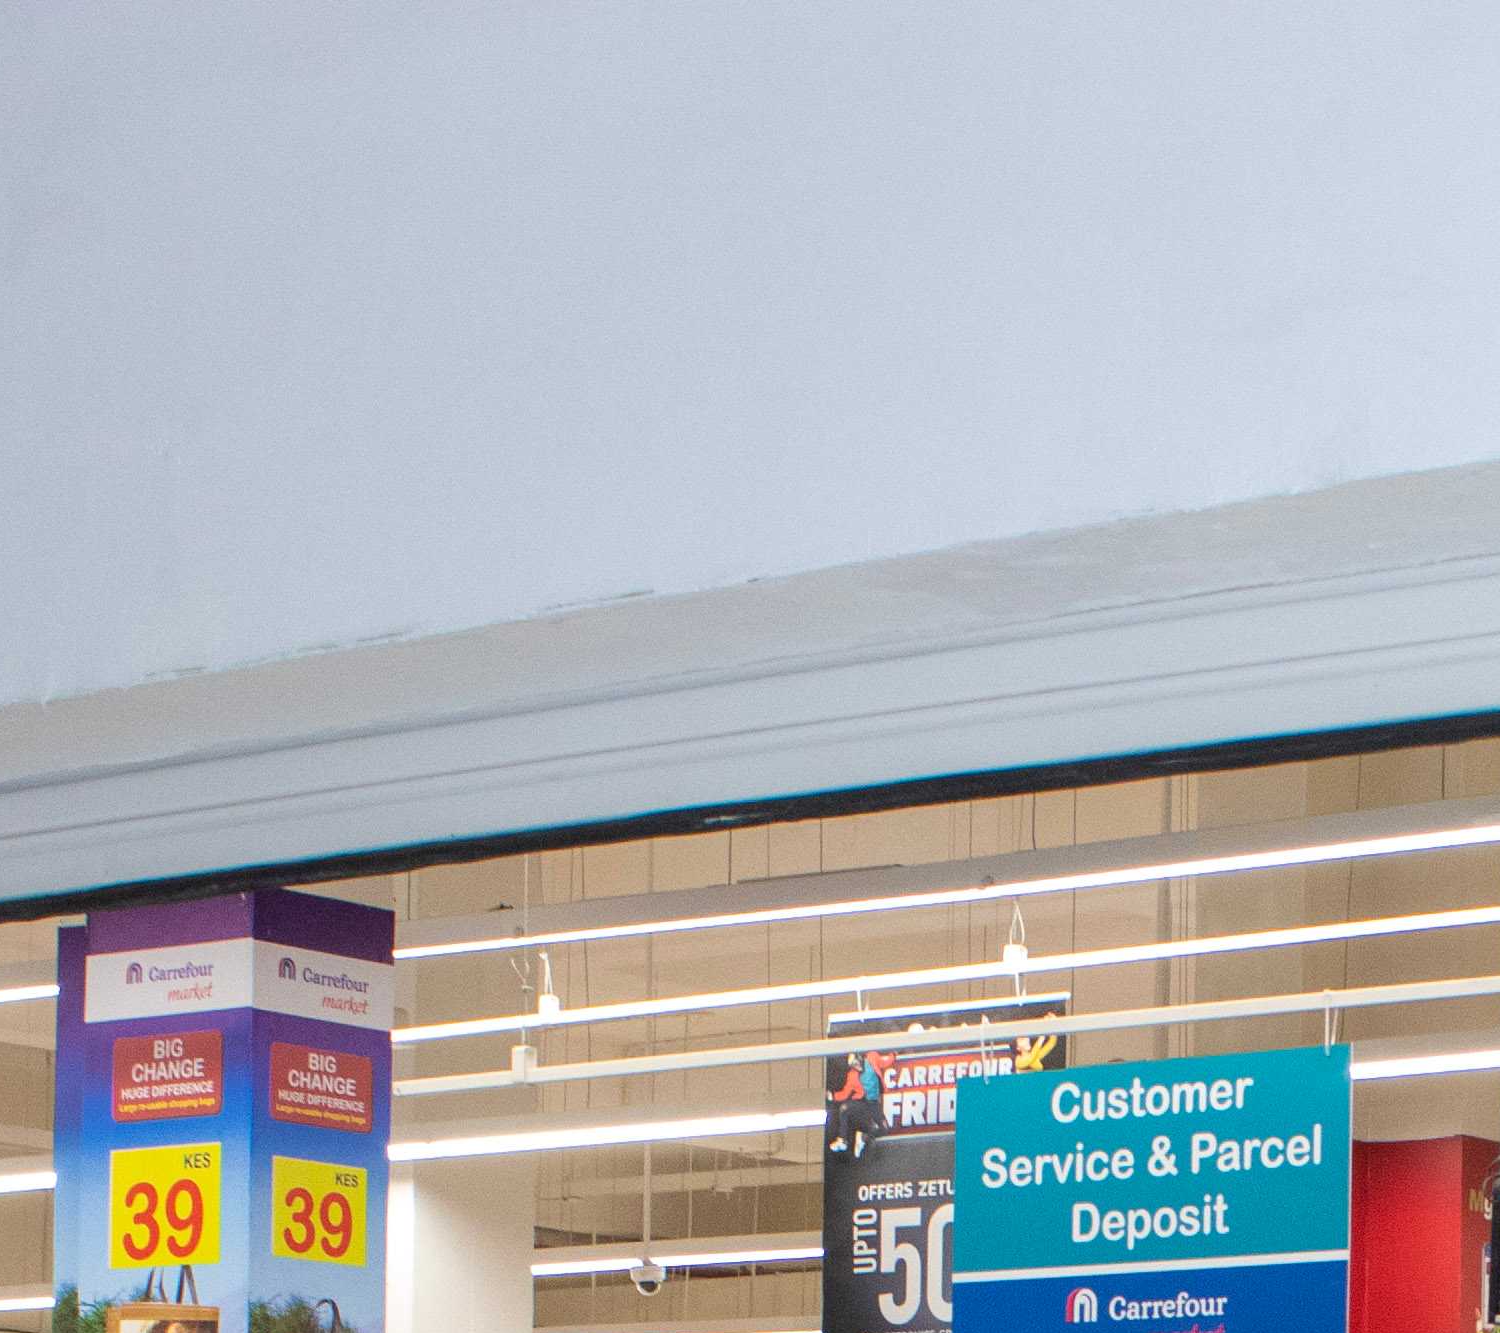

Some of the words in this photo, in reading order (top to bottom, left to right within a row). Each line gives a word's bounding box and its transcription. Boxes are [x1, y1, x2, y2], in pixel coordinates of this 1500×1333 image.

[168, 984, 212, 1002] market
[303, 968, 369, 993] Carrefour
[131, 1058, 204, 1083] CHANGE
[288, 1070, 356, 1096] CHANGE
[1051, 1076, 1253, 1123] Customer
[184, 1153, 211, 1169] KES
[982, 1143, 1134, 1190] Service
[1148, 1136, 1177, 1176] &
[1191, 1124, 1322, 1173] Parcel
[336, 1173, 359, 1188] KES
[123, 1178, 204, 1261] 39
[284, 1187, 353, 1258] 39
[1072, 1194, 1229, 1250] Deposit
[1109, 1290, 1228, 1321] Carrefour
